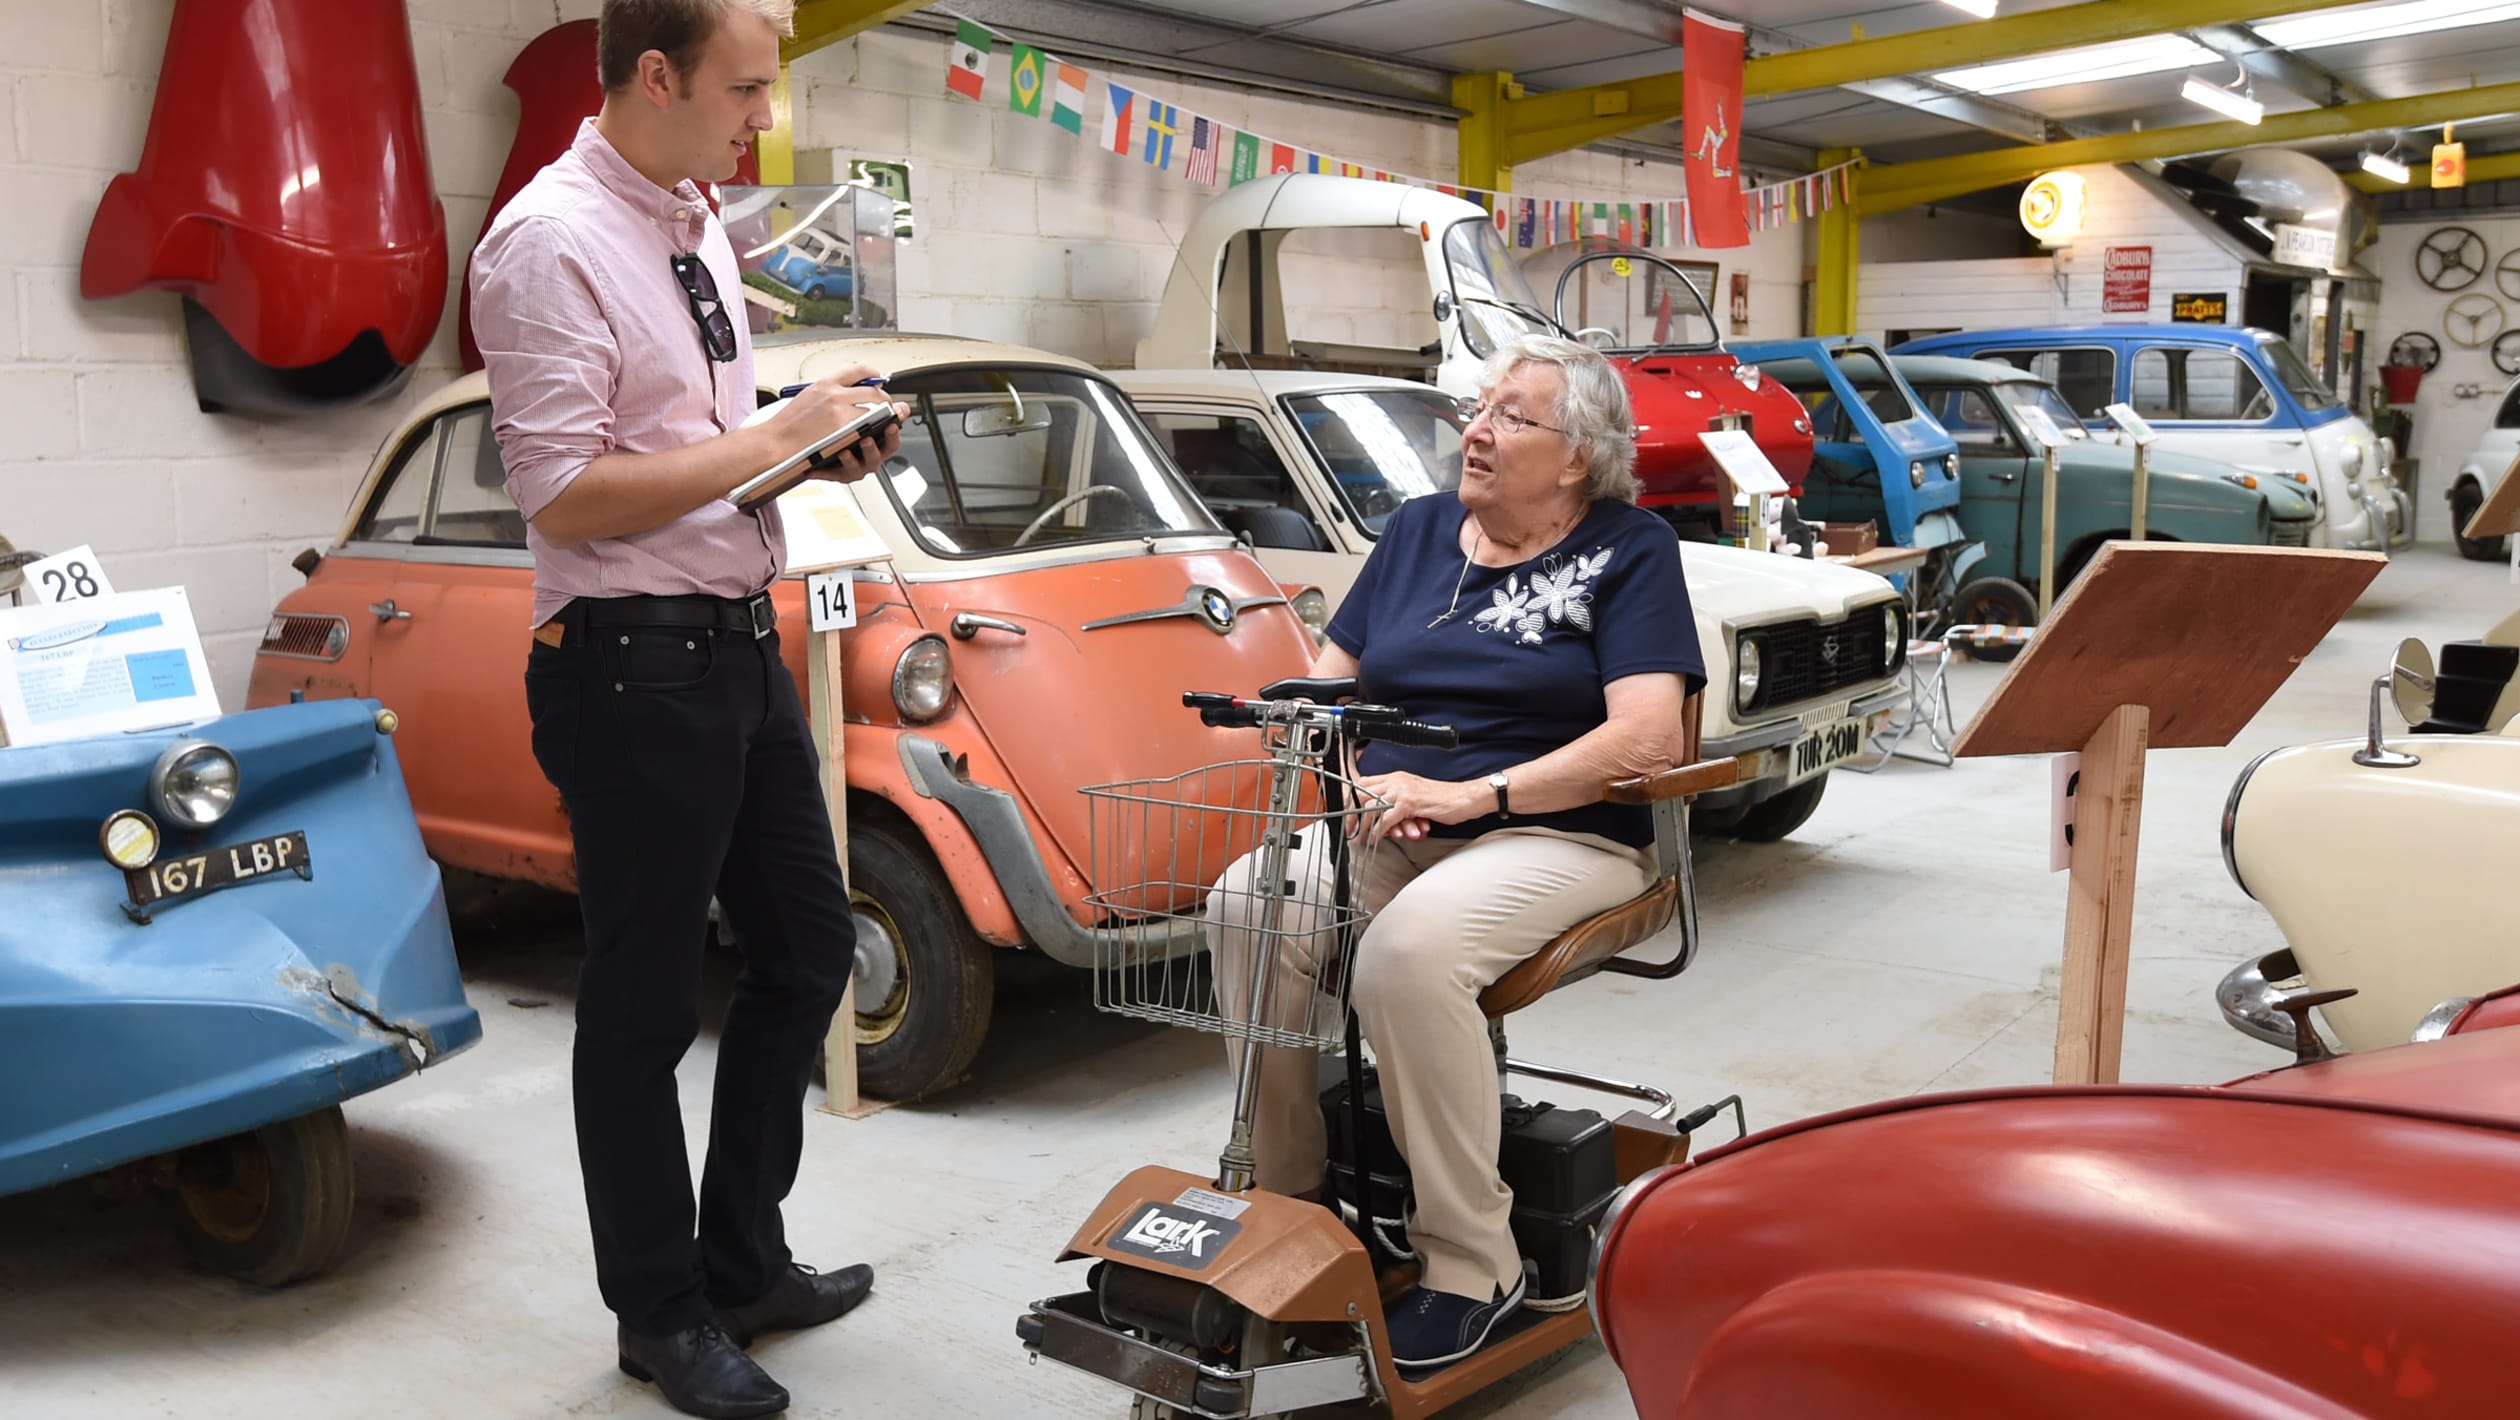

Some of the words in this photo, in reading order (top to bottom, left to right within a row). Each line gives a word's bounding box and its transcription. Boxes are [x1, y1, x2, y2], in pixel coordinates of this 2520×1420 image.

[43, 561, 99, 602] 28
[817, 582, 848, 621] 14
[1796, 732, 1823, 777] TUR
[150, 855, 207, 898] 167
[230, 837, 293, 879] LBP
[1123, 1207, 1221, 1257] Lark
